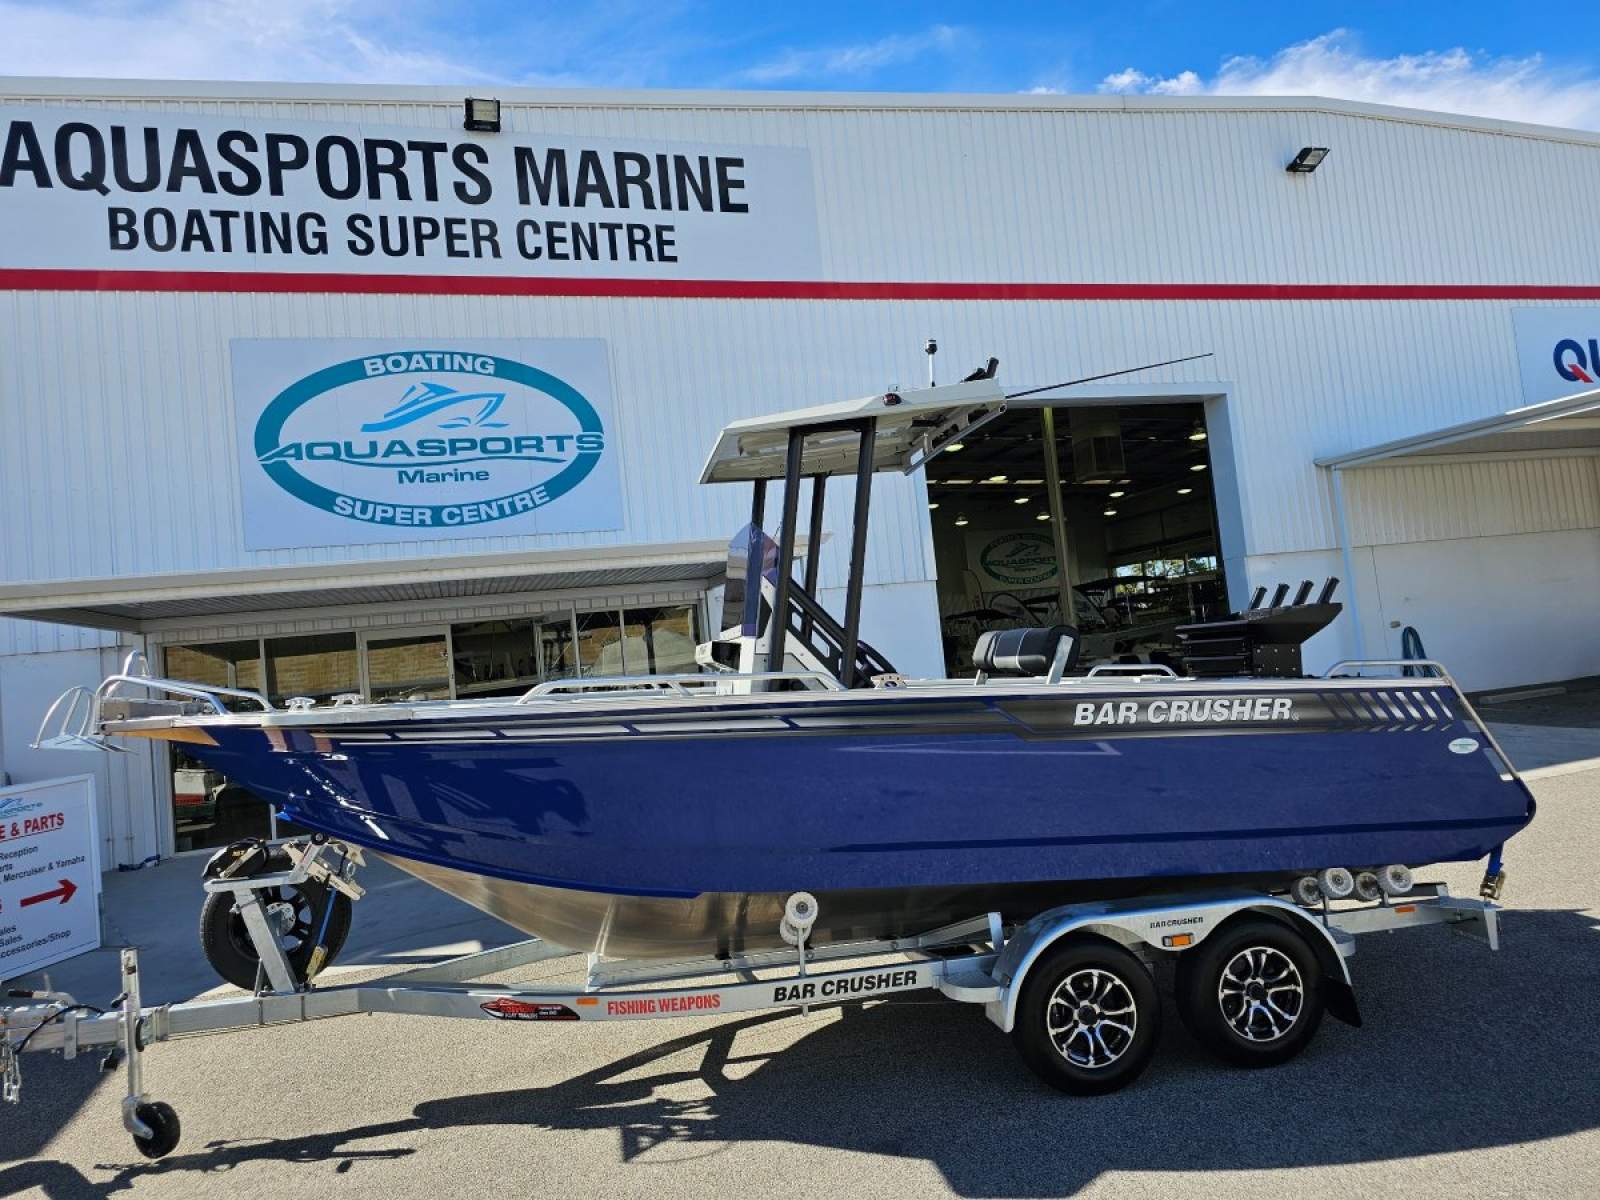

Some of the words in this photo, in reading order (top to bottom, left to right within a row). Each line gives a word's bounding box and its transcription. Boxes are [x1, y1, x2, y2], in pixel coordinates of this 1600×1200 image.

[0, 121, 492, 205] AQUASPORTS
[514, 146, 749, 213] MARINE
[108, 206, 328, 255] BOATING
[346, 213, 502, 259] SUPER
[516, 219, 678, 263] CENTRE
[363, 353, 496, 376] BOATING
[258, 432, 605, 462] AQUASPORTS
[398, 469, 490, 484] Marine
[333, 496, 432, 525] SUPER
[441, 486, 549, 525] CENTRE
[1074, 702, 1137, 726] BAR
[1147, 698, 1293, 724] CRUSHER
[11, 822, 20, 836] &
[24, 812, 65, 834] PARTS
[4, 866, 46, 882] Mercruiser
[56, 855, 85, 868] Yamaha
[773, 984, 815, 1003] BAR
[820, 970, 918, 996] CRUSHER
[607, 999, 657, 1016] FISHING
[658, 994, 721, 1013] WEAPONS
